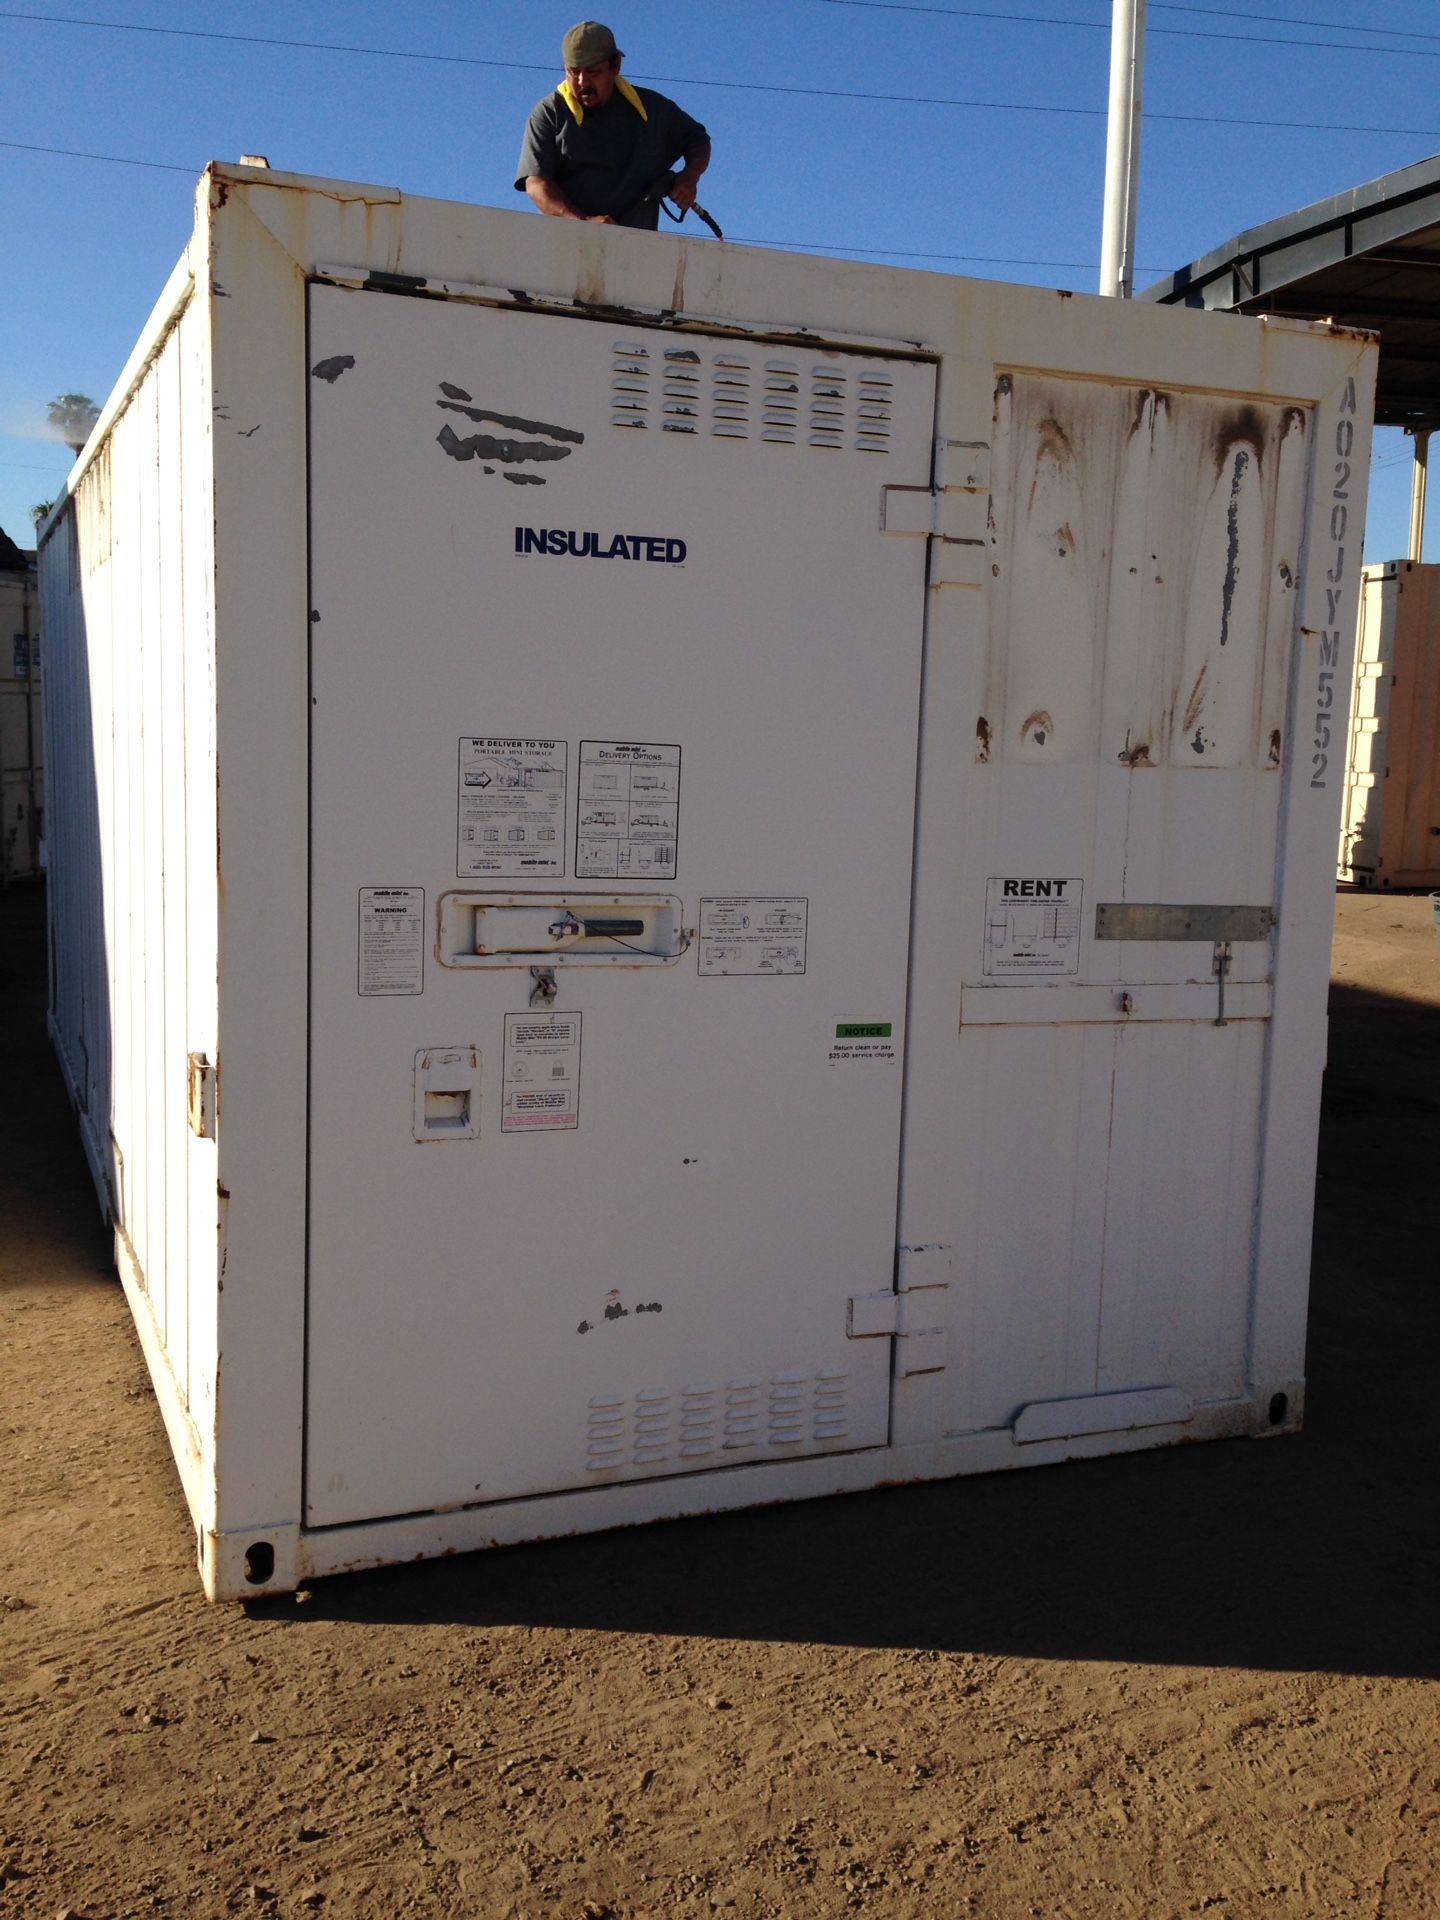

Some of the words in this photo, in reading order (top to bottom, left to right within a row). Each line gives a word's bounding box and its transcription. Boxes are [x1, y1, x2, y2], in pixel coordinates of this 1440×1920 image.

[515, 527, 687, 563] INSULATED
[1003, 879, 1068, 897] RENT
[845, 1026, 883, 1036] NOTICE
